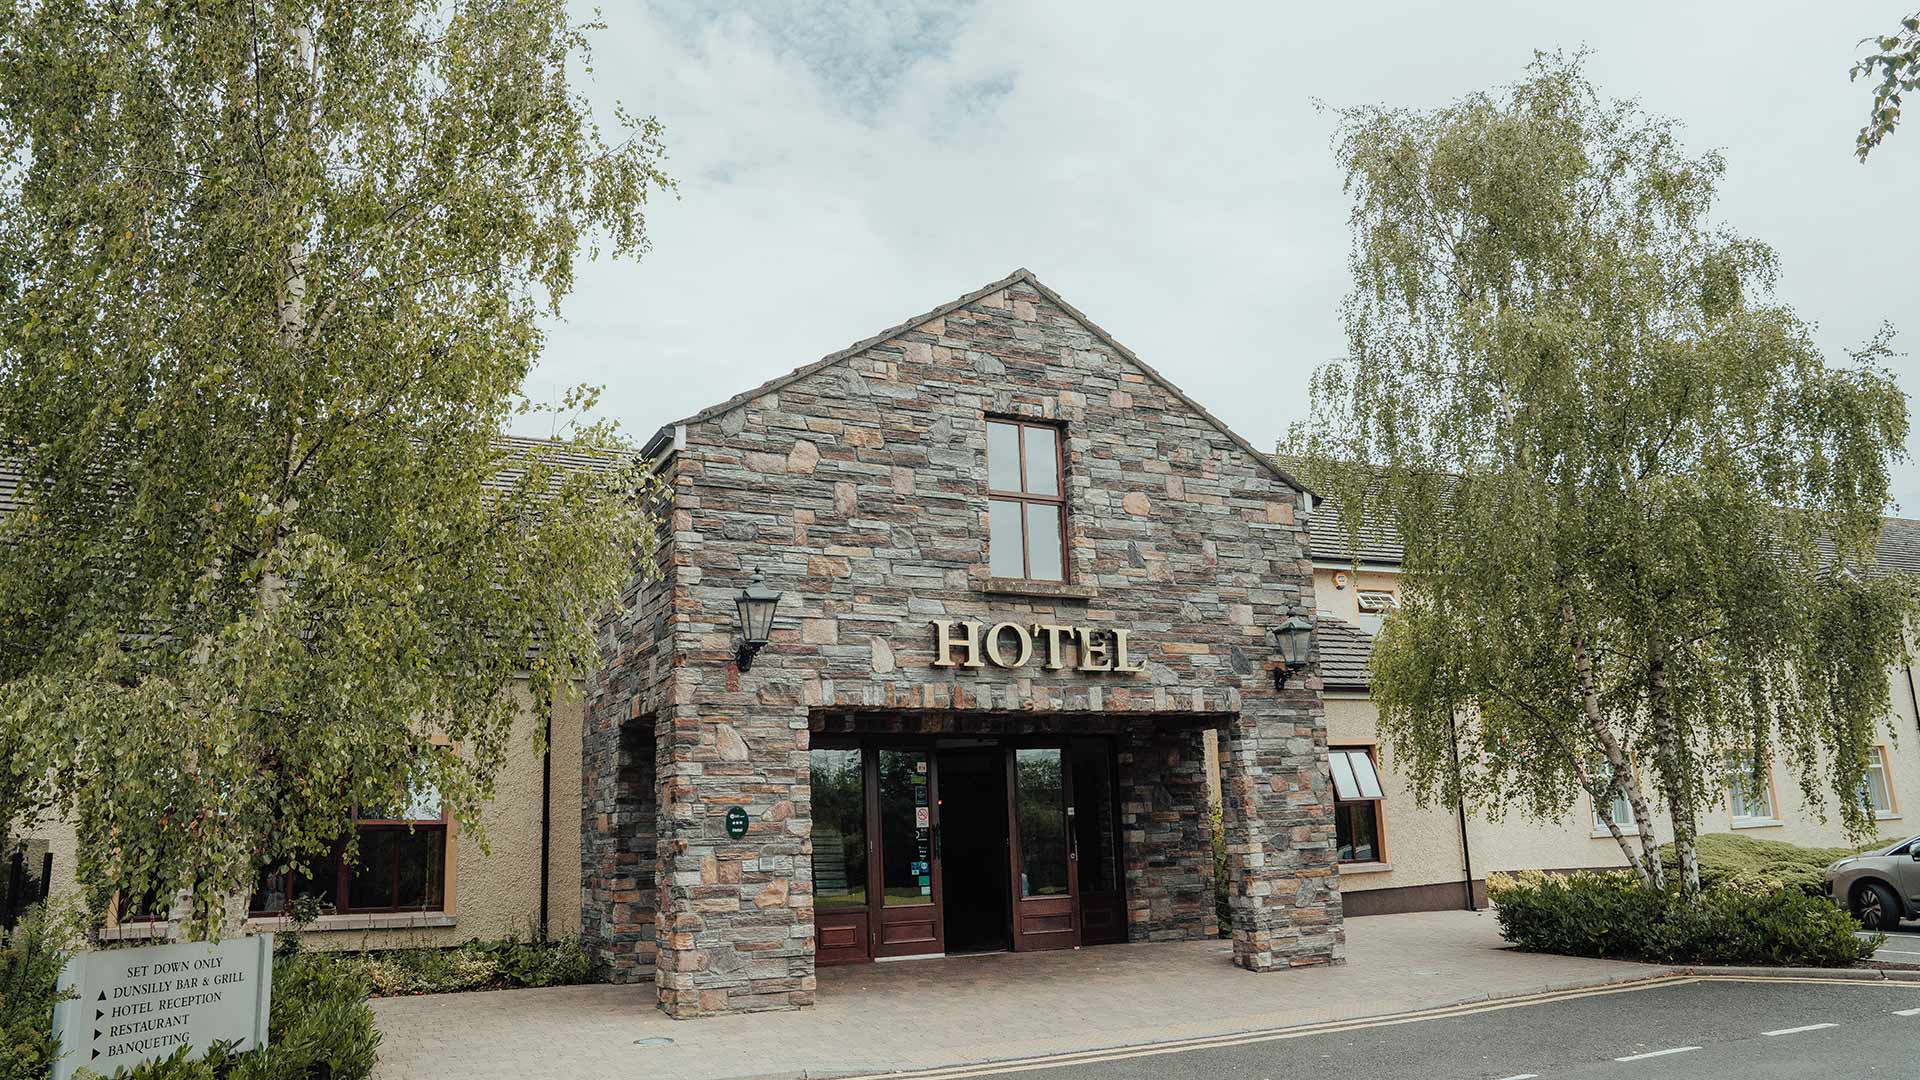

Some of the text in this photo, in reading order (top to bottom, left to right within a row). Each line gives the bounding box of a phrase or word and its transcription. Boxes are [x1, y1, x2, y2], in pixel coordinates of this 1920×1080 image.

[931, 619, 1147, 673] HOTEL
[127, 957, 223, 978] SET DOWN ONLY
[114, 972, 244, 998] DUNSILLY BAR & GRILL
[112, 992, 221, 1017] HOTEL RECEPTION
[110, 1015, 190, 1037] RESTAURANT
[108, 1032, 190, 1056] BANQUETING
